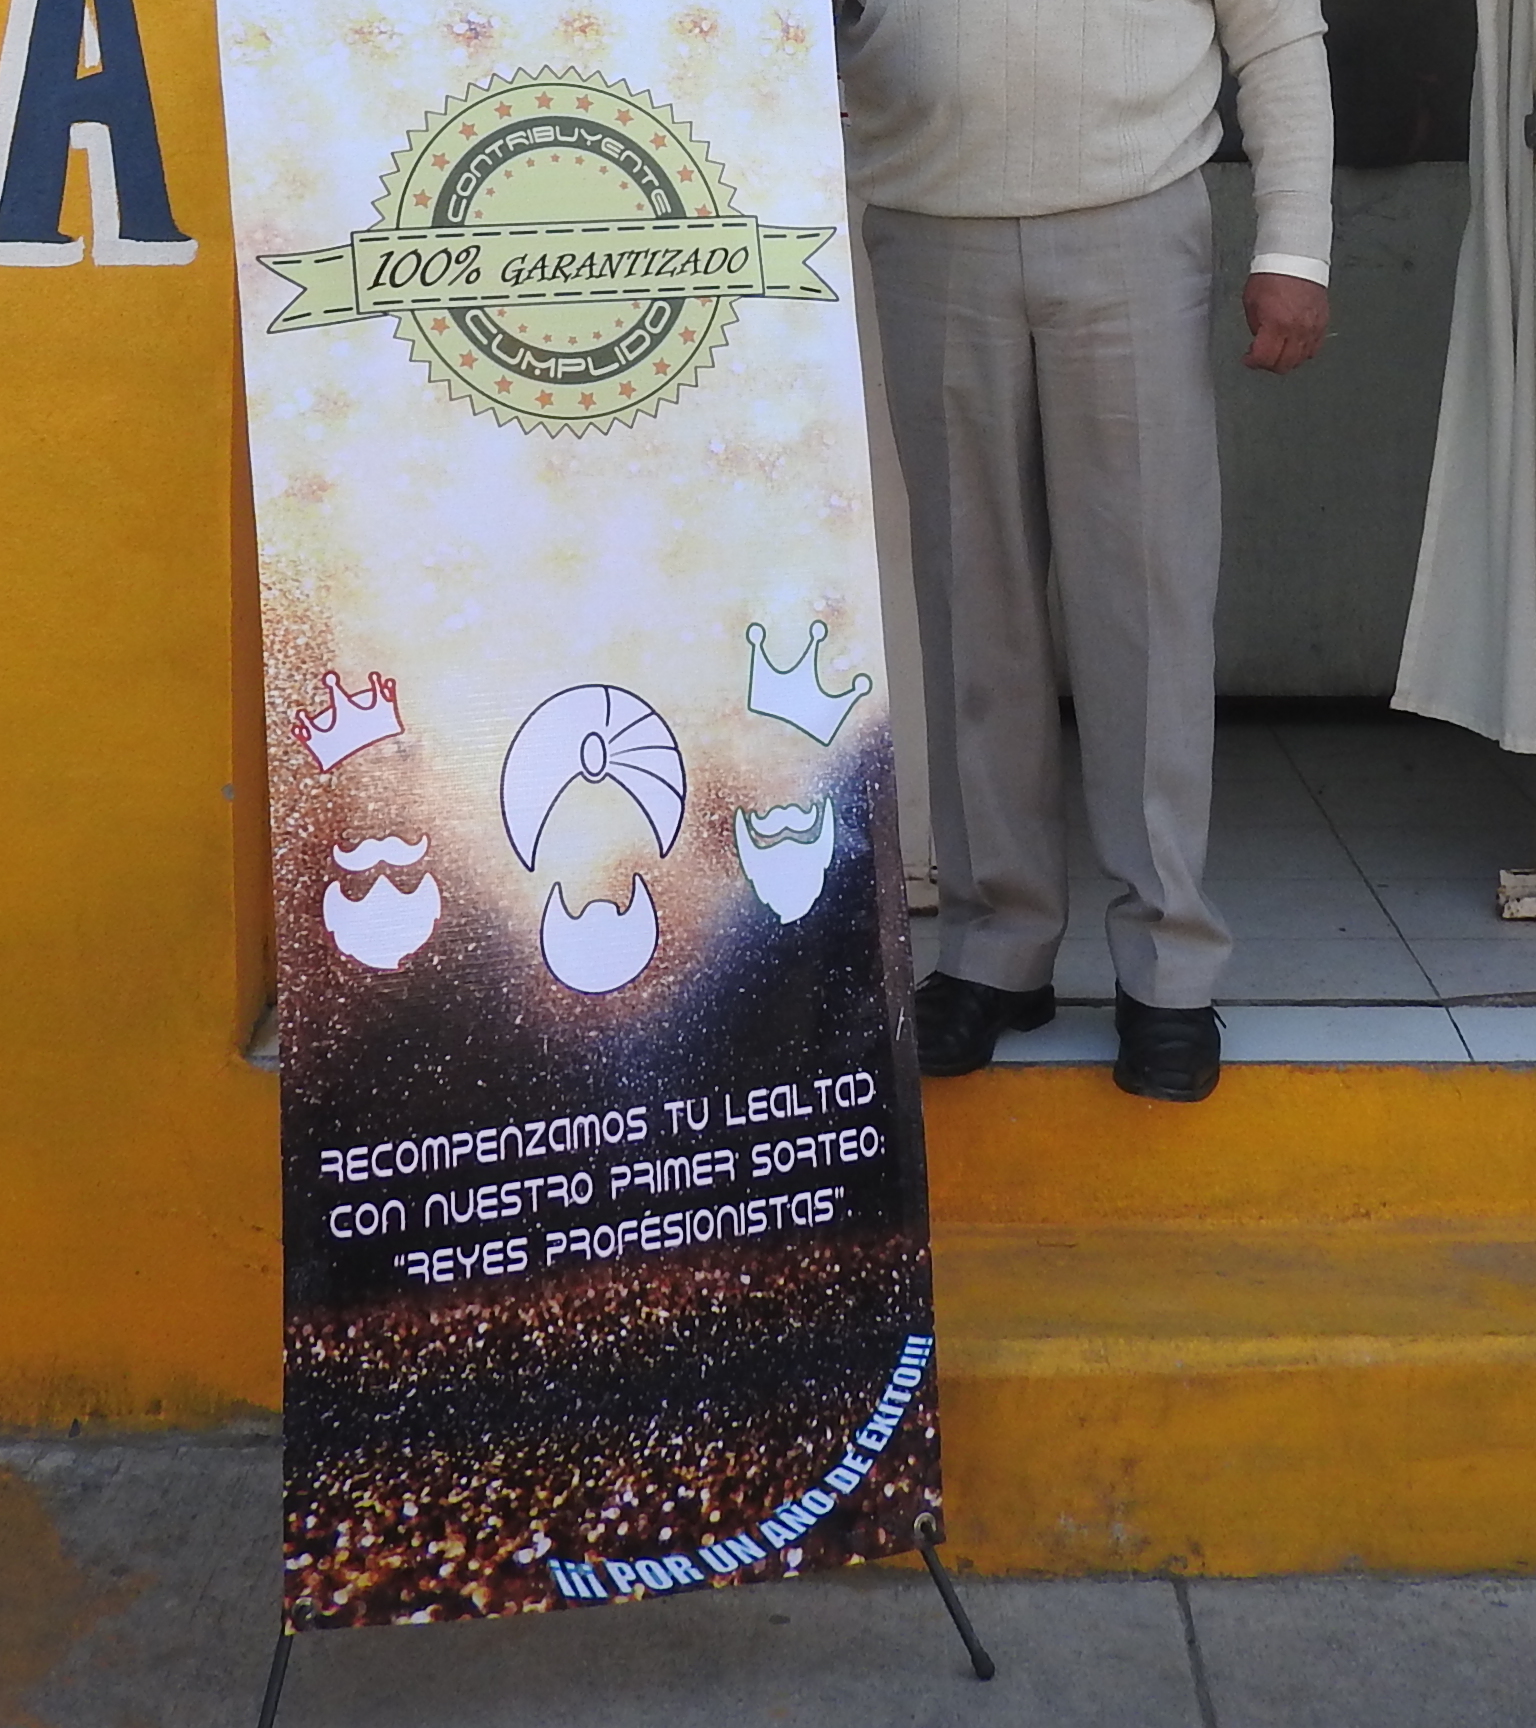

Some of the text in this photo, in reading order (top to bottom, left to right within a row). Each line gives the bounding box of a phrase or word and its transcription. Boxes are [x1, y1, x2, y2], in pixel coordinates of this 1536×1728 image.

[447, 125, 672, 223] CONTRIBUYENTE
[366, 244, 750, 291] 100% GARANTIZADO
[465, 300, 672, 379] CUMPLIDO
[320, 1071, 876, 1183] RECOMPENZAMOS TU LEALTAD
[329, 1124, 886, 1239] CON NUESTRO PRIMER SORTEO:
[393, 1185, 846, 1285] "REYES PROFESIONISTAS"
[604, 1553, 704, 1594] POR
[697, 1532, 767, 1574] UN
[760, 1488, 836, 1549] AÑO
[824, 1449, 874, 1494] DE
